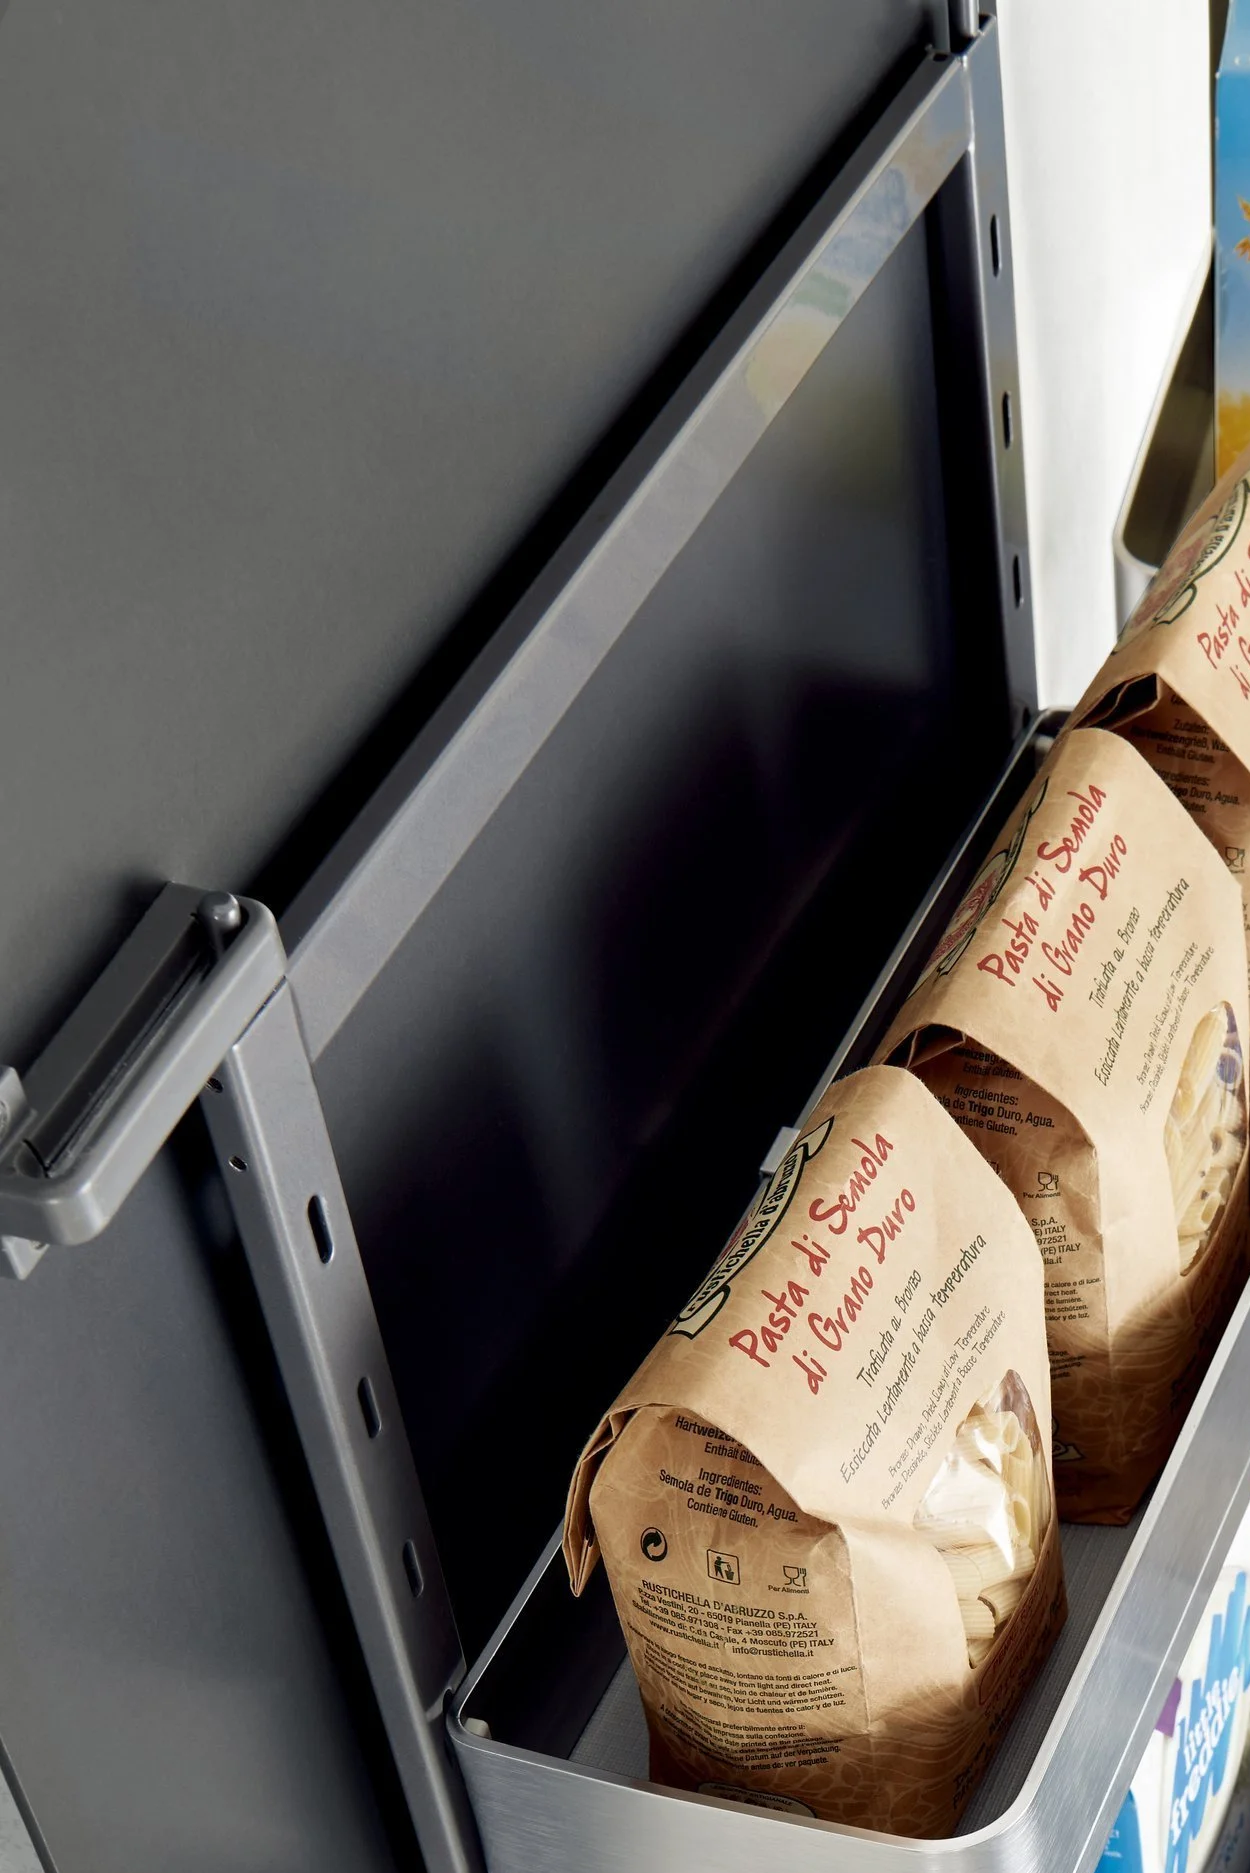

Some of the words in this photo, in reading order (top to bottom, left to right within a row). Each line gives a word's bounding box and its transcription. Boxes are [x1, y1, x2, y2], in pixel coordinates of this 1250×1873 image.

[1197, 604, 1240, 670] Pasta
[1190, 786, 1212, 801] Duro,
[1214, 792, 1239, 806] Agua.
[1037, 784, 1107, 874] Semola
[1078, 834, 1128, 901] Duro
[1024, 869, 1056, 912] di
[1041, 902, 1096, 977] Grano
[1117, 906, 1140, 946] Bronzo
[977, 910, 1039, 987] Pasta
[1032, 973, 1065, 1013] di
[1094, 1035, 1121, 1088] Essiccata
[1148, 877, 1190, 944] temperatura
[952, 1098, 965, 1110] de
[967, 1100, 995, 1117] Trigo
[997, 1106, 1024, 1124] Duro,
[1026, 1111, 1055, 1128] Agua.
[954, 1083, 1019, 1106] Ingredientes:
[986, 1119, 1018, 1136] Gluten.
[808, 1133, 894, 1236] Semola
[857, 1188, 917, 1266] Duro
[1031, 1216, 1058, 1227] S.p.A.
[1044, 1225, 1066, 1236] ITALY
[791, 1233, 831, 1278] di
[1058, 1242, 1081, 1254] ITALY
[729, 1279, 810, 1368] Pasta
[808, 1265, 873, 1353] Grano
[856, 1329, 896, 1390] Trafilata
[894, 1269, 923, 1315] Bronzo
[792, 1350, 829, 1396] di
[840, 1418, 881, 1485] Essiccata
[876, 1350, 917, 1427] Lentamente
[912, 1341, 922, 1356] a
[918, 1307, 937, 1344] bassa
[931, 1234, 988, 1310] temperatura
[704, 1441, 738, 1460] Enthält
[659, 1469, 694, 1494] Semola
[696, 1484, 711, 1498] de
[715, 1487, 739, 1506] Trigo
[740, 1495, 765, 1516] Duro,
[767, 1504, 799, 1522] Agua.
[698, 1467, 763, 1496] Ingredientes:
[687, 1498, 728, 1518] Contiene
[729, 1509, 758, 1528] Gluten.
[641, 1579, 710, 1609] RUSTICHELLA
[713, 1600, 775, 1620] D'ABRUZZO
[778, 1611, 808, 1622] S.p.A.
[768, 1585, 780, 1593] Per
[781, 1586, 810, 1594] Alimenti
[653, 1604, 669, 1616] +39
[671, 1609, 720, 1631] 085.971308
[726, 1625, 743, 1636] Fax
[745, 1628, 764, 1638] +39
[766, 1628, 819, 1638] 085.972521
[656, 1595, 686, 1613] Vestini,
[687, 1604, 699, 1616] 20
[706, 1611, 733, 1624] 65019
[735, 1618, 771, 1629] Pianella
[773, 1621, 791, 1631] (PE)
[793, 1621, 817, 1630] ITALY
[732, 1645, 814, 1658] info@rustichella.it
[741, 1636, 748, 1645] 4
[789, 1640, 808, 1649] (PE)
[809, 1638, 835, 1648] ITALY
[736, 1671, 763, 1681] lontano
[764, 1673, 775, 1681] da
[775, 1673, 793, 1682] fonti
[802, 1671, 825, 1681] calore
[840, 1665, 858, 1674] luce.
[738, 1680, 756, 1688] from
[757, 1681, 774, 1691] light
[774, 1682, 789, 1690] and
[790, 1681, 813, 1690] direct
[814, 1678, 832, 1686] heat.
[756, 1705, 784, 1714] fuentes
[796, 1703, 814, 1713] calor
